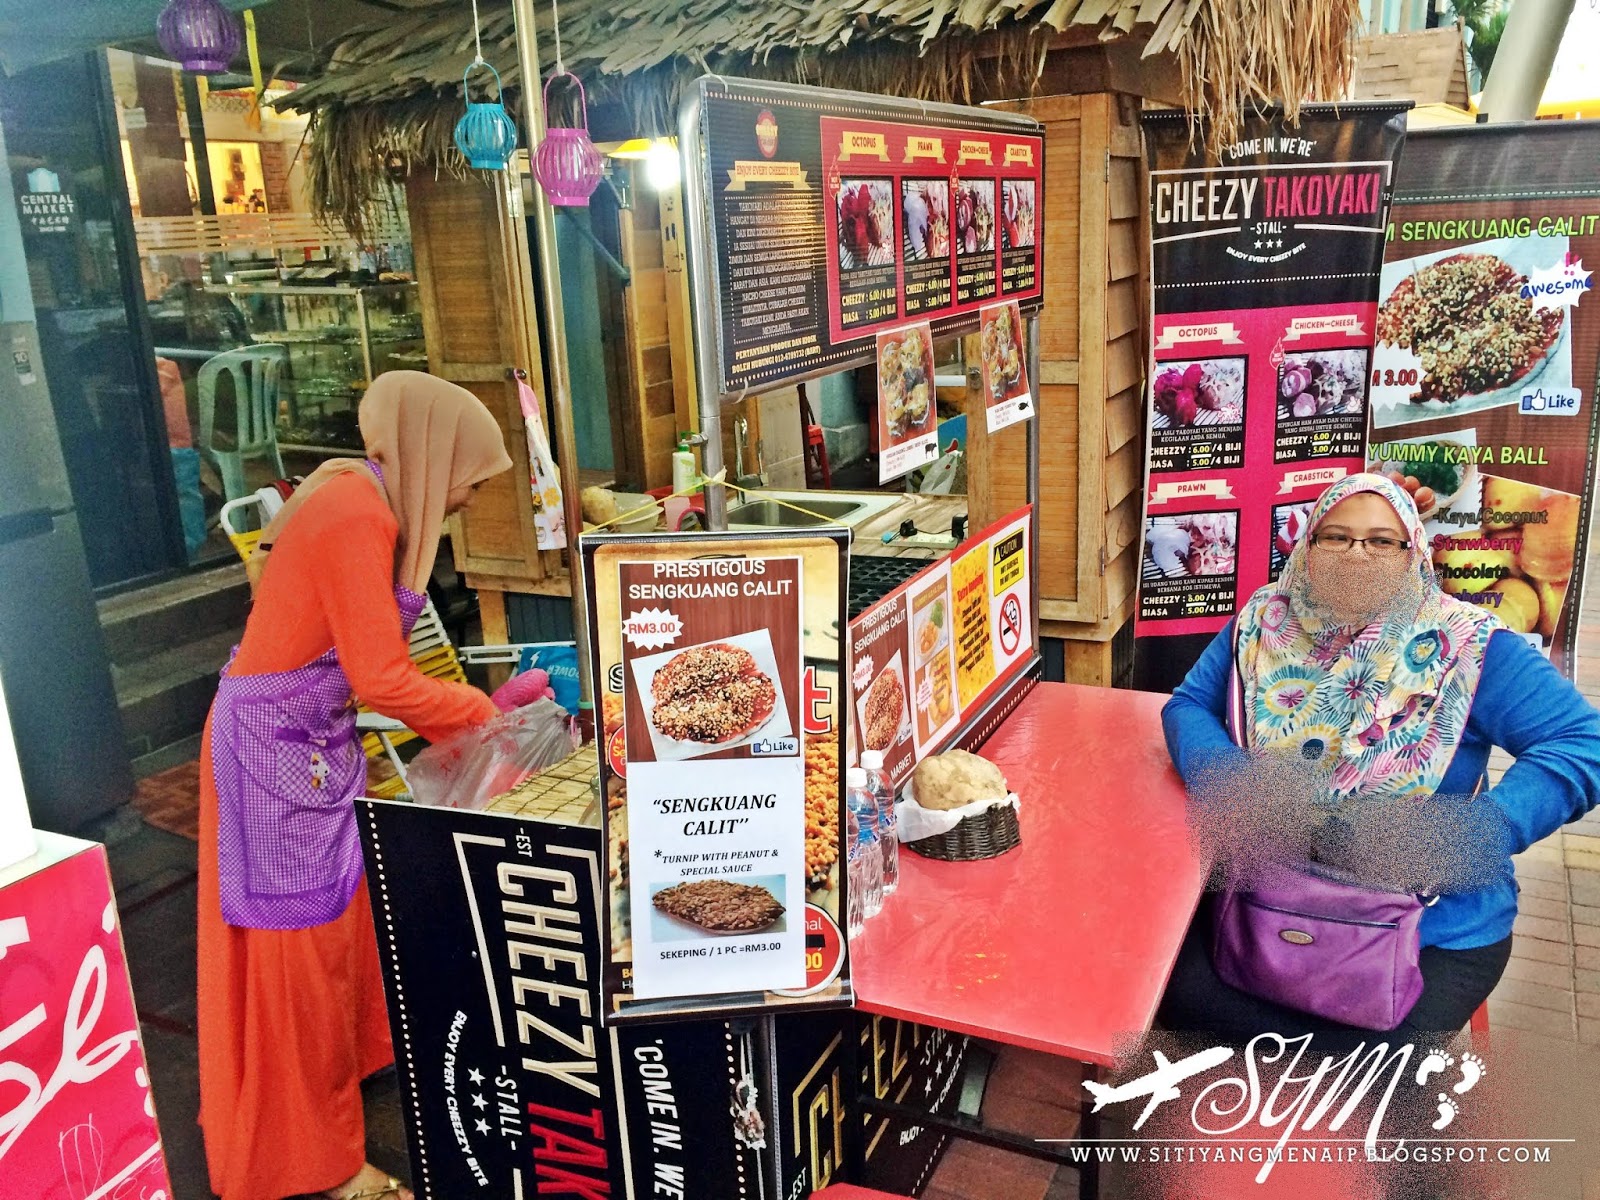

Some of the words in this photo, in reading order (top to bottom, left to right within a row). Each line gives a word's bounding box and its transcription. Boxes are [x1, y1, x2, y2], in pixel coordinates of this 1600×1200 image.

[852, 135, 877, 148] OCTOPUS
[917, 142, 933, 151] PRAWN
[1264, 138, 1277, 154] IN.
[20, 194, 74, 205] CENTRAL
[1156, 178, 1258, 224] CHEEZY
[1264, 173, 1381, 218] TAKOYAKI
[22, 203, 75, 214] MARKET
[1401, 218, 1531, 241] SENGKUANG
[1537, 215, 1599, 237] CALIT
[1226, 246, 1248, 260] ENJOY
[1248, 255, 1269, 263] EVERY
[1292, 242, 1307, 255] BITE
[1520, 276, 1594, 300] awesome
[841, 292, 865, 307] CHEEZZY
[842, 311, 859, 324] BIASA
[1178, 326, 1218, 338] OCTOPUS
[731, 361, 751, 374] BOLEH
[1384, 369, 1418, 386] 3.00
[1548, 396, 1575, 409] Like
[1225, 442, 1241, 451] BIJI
[1276, 436, 1308, 447] CHEEZZY
[1344, 432, 1361, 441] BIJI
[1224, 455, 1240, 464] BIJI
[1275, 449, 1297, 460] BIASA
[1342, 445, 1359, 453] BIJI
[1367, 444, 1439, 464] YUMMY
[1443, 446, 1494, 464] KAYA
[1500, 446, 1549, 465] BALL
[1293, 471, 1335, 483] CRABSTICK
[1177, 483, 1206, 493] PRAWN
[653, 559, 766, 578] PRESTIGOUS
[628, 583, 739, 600] SENGKUANG
[743, 579, 793, 597] CALIT
[1143, 595, 1180, 605] CHEEZZY
[1218, 591, 1234, 599] BIJI
[862, 598, 898, 632] PRESTIGOUS
[1142, 608, 1168, 617] BIASA
[1217, 603, 1233, 612] BIJI
[628, 622, 675, 634] RM3.00
[854, 621, 890, 654] SENGKUANG
[890, 609, 906, 629] CALIT
[773, 741, 794, 752] Like
[890, 752, 912, 781] MARKET
[702, 852, 728, 862] WITH
[730, 849, 770, 860] PEANUT
[772, 849, 779, 857] &
[680, 865, 720, 876] SPECIAL
[722, 863, 753, 874] SAUCE
[660, 948, 707, 960] SEKEPING
[709, 946, 713, 958] /
[717, 947, 721, 955] 1
[725, 945, 737, 954] PC
[497, 861, 600, 1098] CHEEZY
[446, 1010, 467, 1053] ENJOY
[443, 1052, 456, 1095] EVERY
[446, 1096, 472, 1154] CHEEZZY
[650, 1121, 683, 1153] IN.
[466, 1157, 490, 1187] BITE
